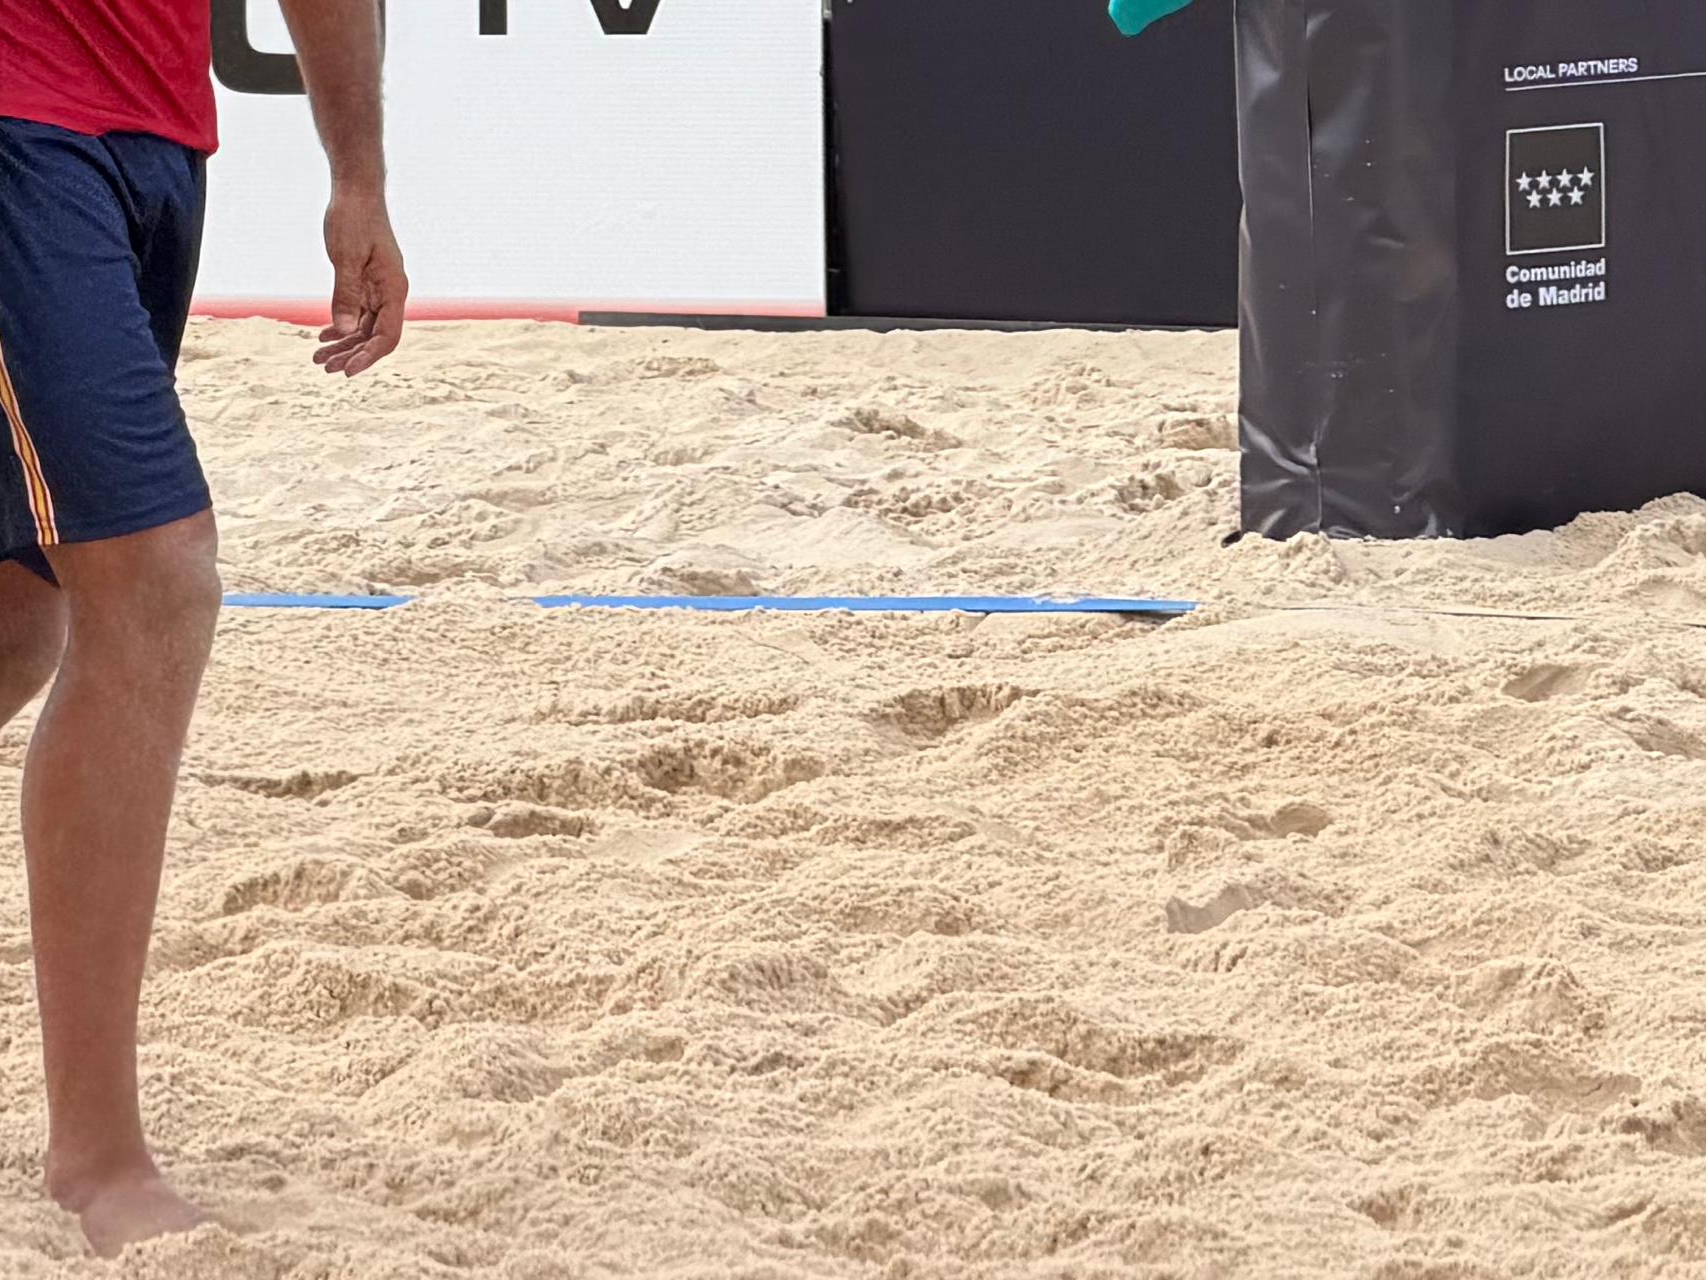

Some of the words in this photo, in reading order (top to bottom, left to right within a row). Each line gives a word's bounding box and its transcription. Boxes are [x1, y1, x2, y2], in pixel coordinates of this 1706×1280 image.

[1504, 63, 1555, 83] LOCAL
[1558, 57, 1638, 78] PARTNERS
[1506, 258, 1606, 283] Comunidad
[1506, 288, 1532, 308] de
[1538, 281, 1606, 307] Madrid
